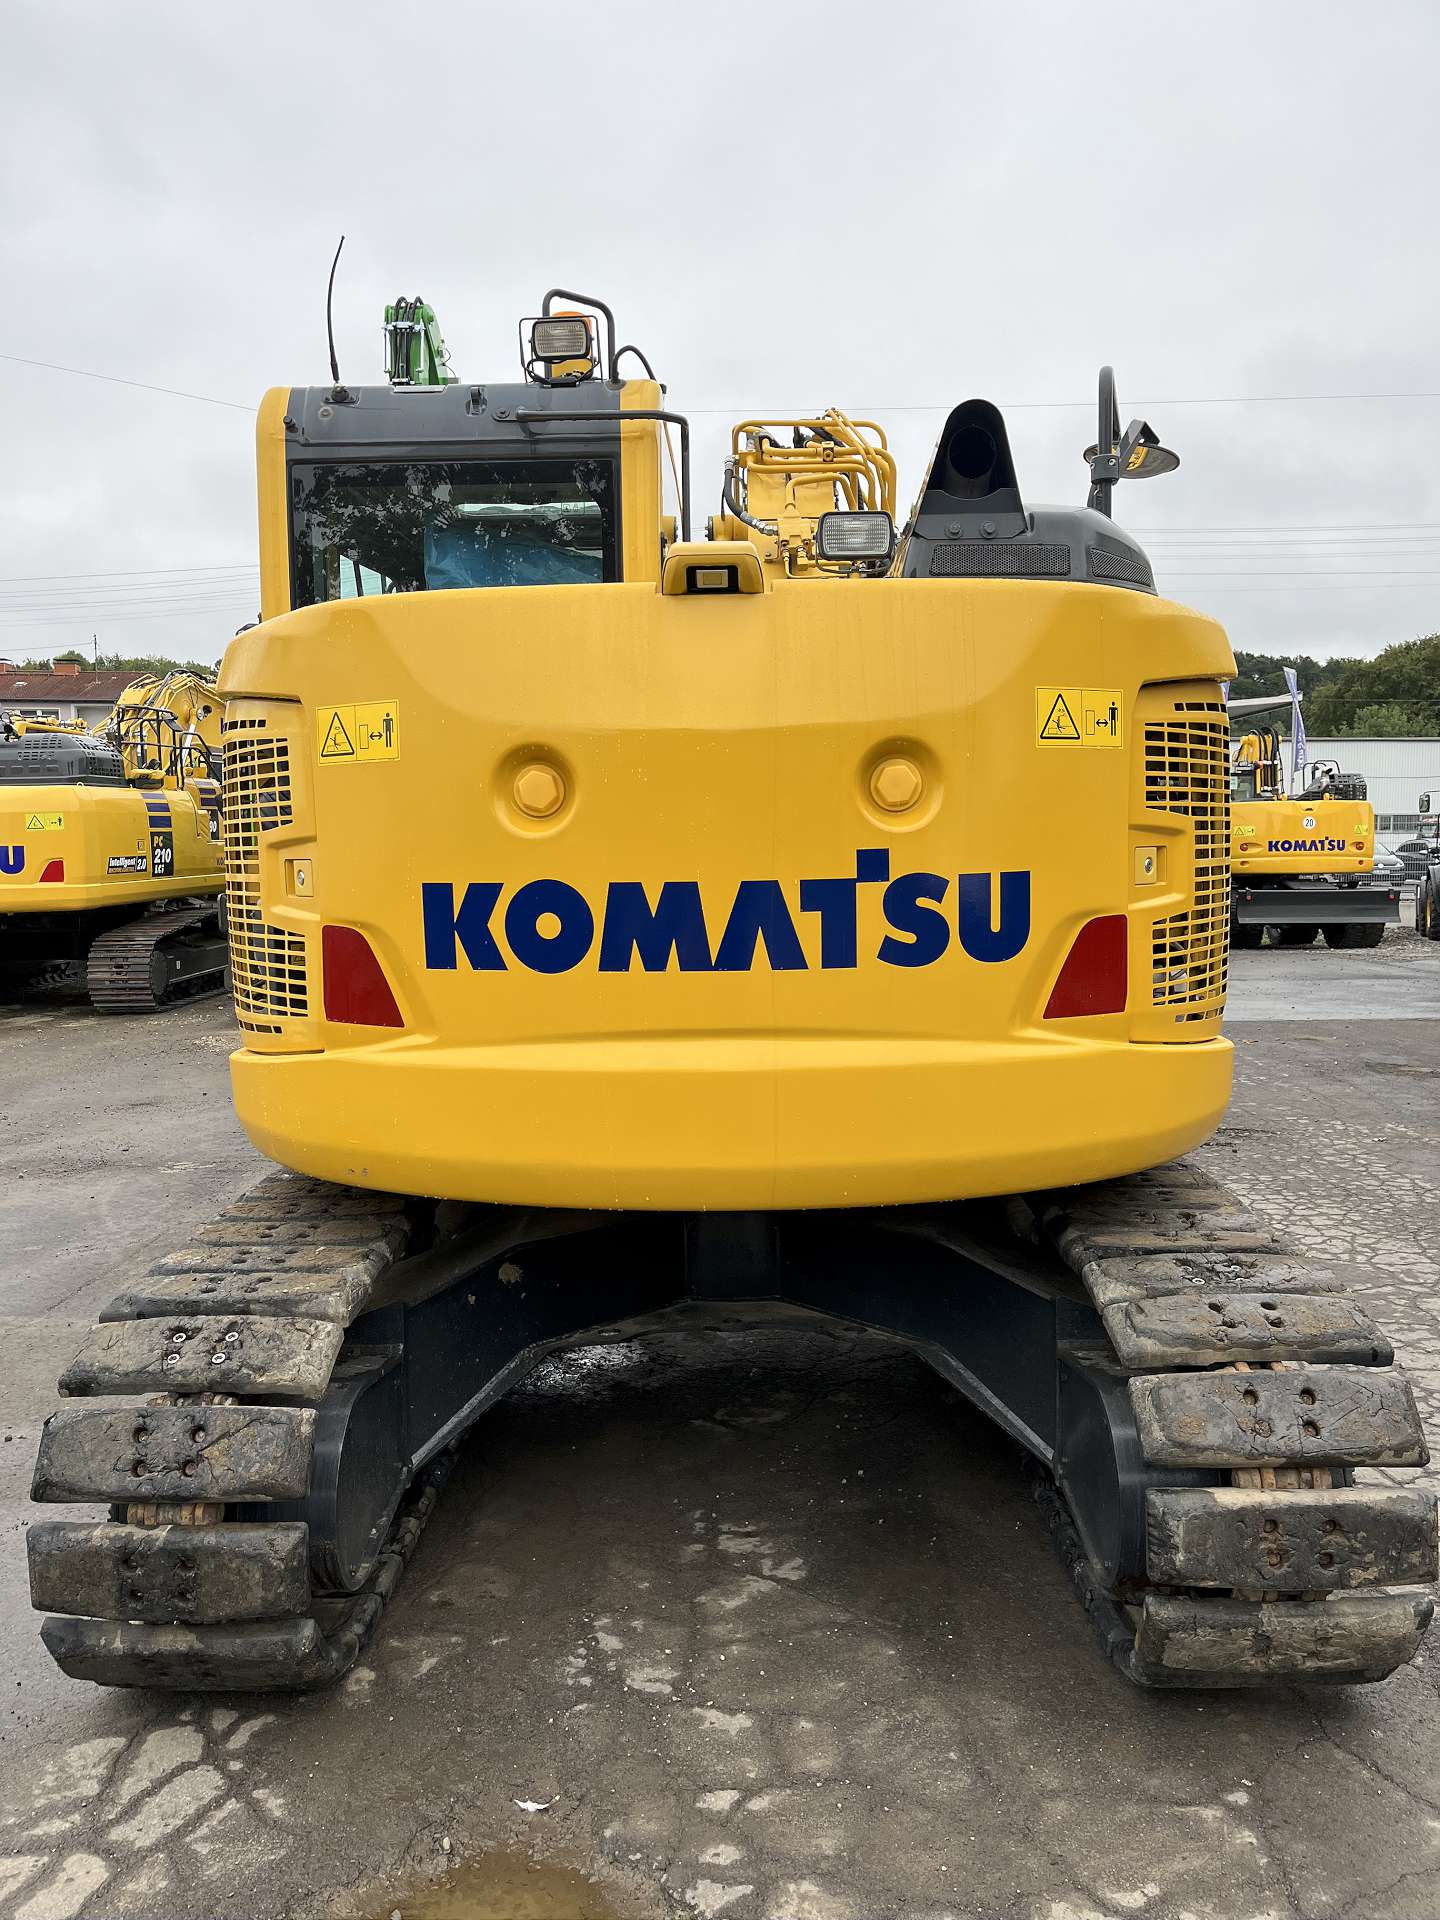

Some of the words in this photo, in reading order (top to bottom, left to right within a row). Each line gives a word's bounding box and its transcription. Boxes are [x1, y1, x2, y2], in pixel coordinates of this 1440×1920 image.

[1305, 818, 1314, 827] 20
[153, 835, 164, 848] PC
[1268, 836, 1346, 852] KOMATSU
[154, 848, 172, 864] 210
[136, 858, 147, 870] 2.0
[423, 849, 1030, 972] KOMATSU
